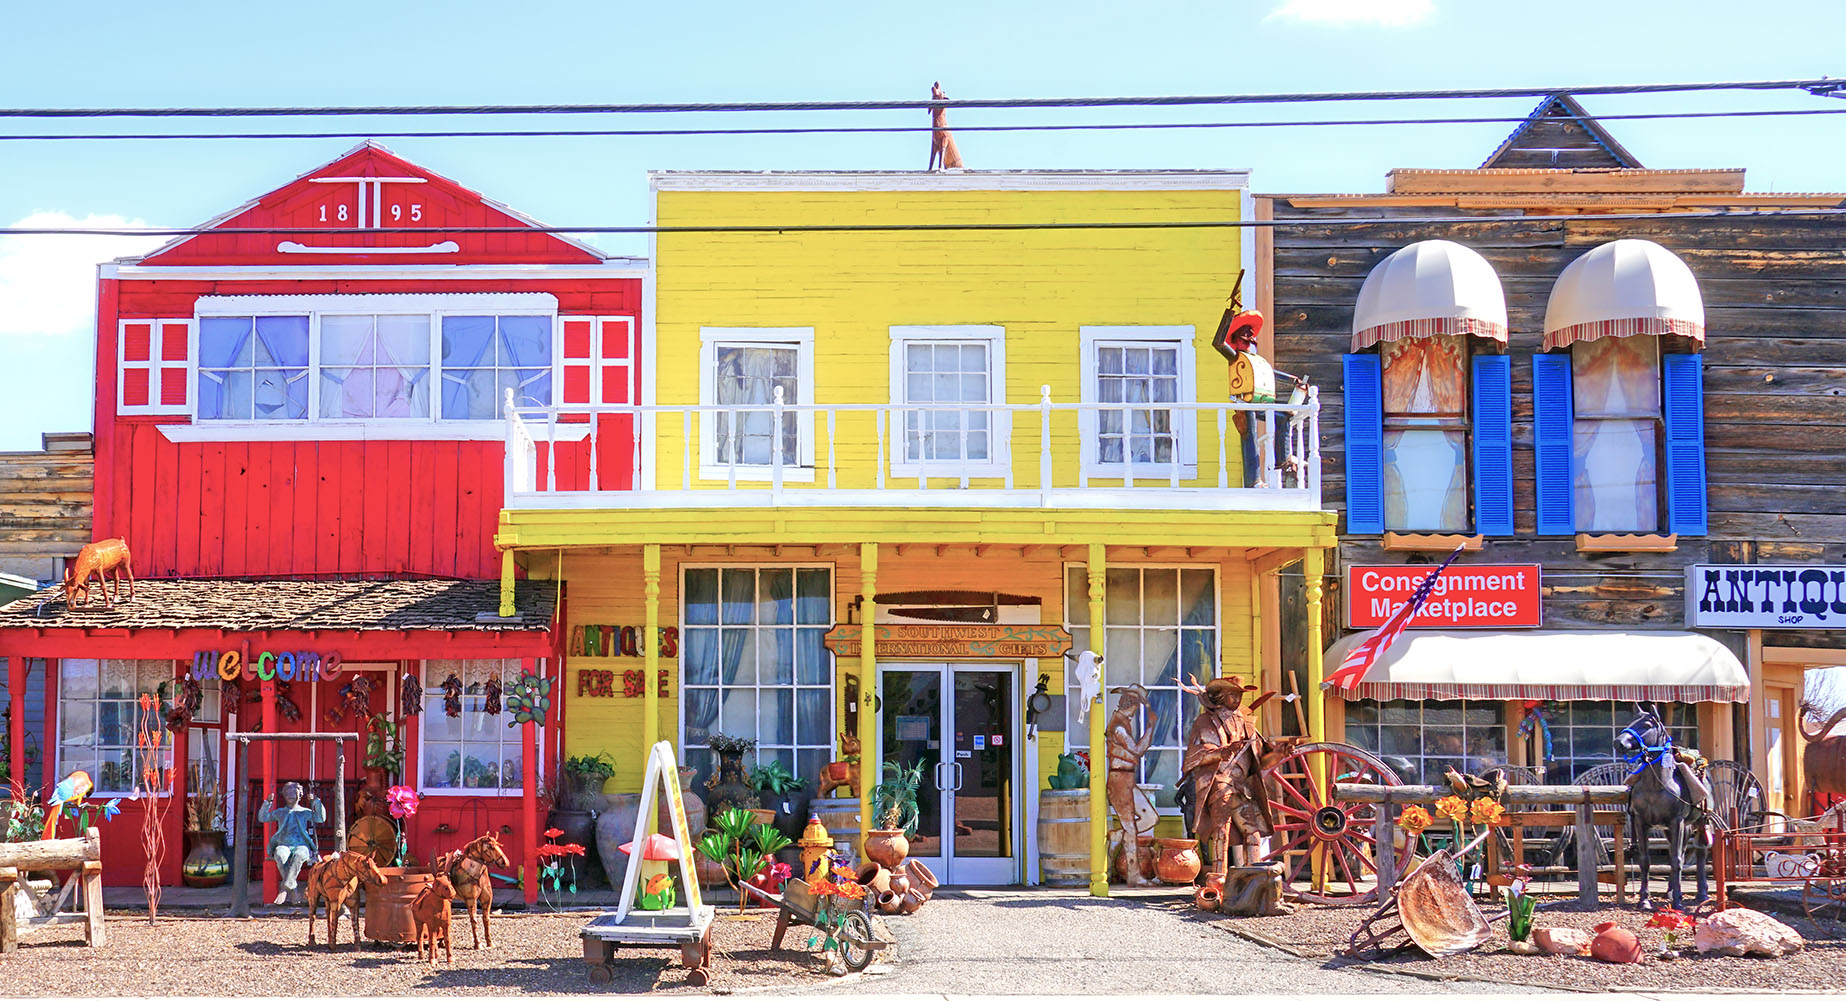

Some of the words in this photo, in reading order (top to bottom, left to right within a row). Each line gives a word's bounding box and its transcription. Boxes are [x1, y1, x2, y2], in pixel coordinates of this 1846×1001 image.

[1361, 571, 1526, 596] Consgnment
[1371, 598, 1517, 622] Mketplace
[1778, 615, 1804, 624] SHOP
[897, 626, 1000, 639] SOUTHWEST
[193, 639, 343, 682] welcome
[850, 642, 969, 655] IERNATIONAL
[999, 643, 1048, 656] GIFTS
[578, 669, 614, 697] FOR
[623, 669, 670, 698] SAE
